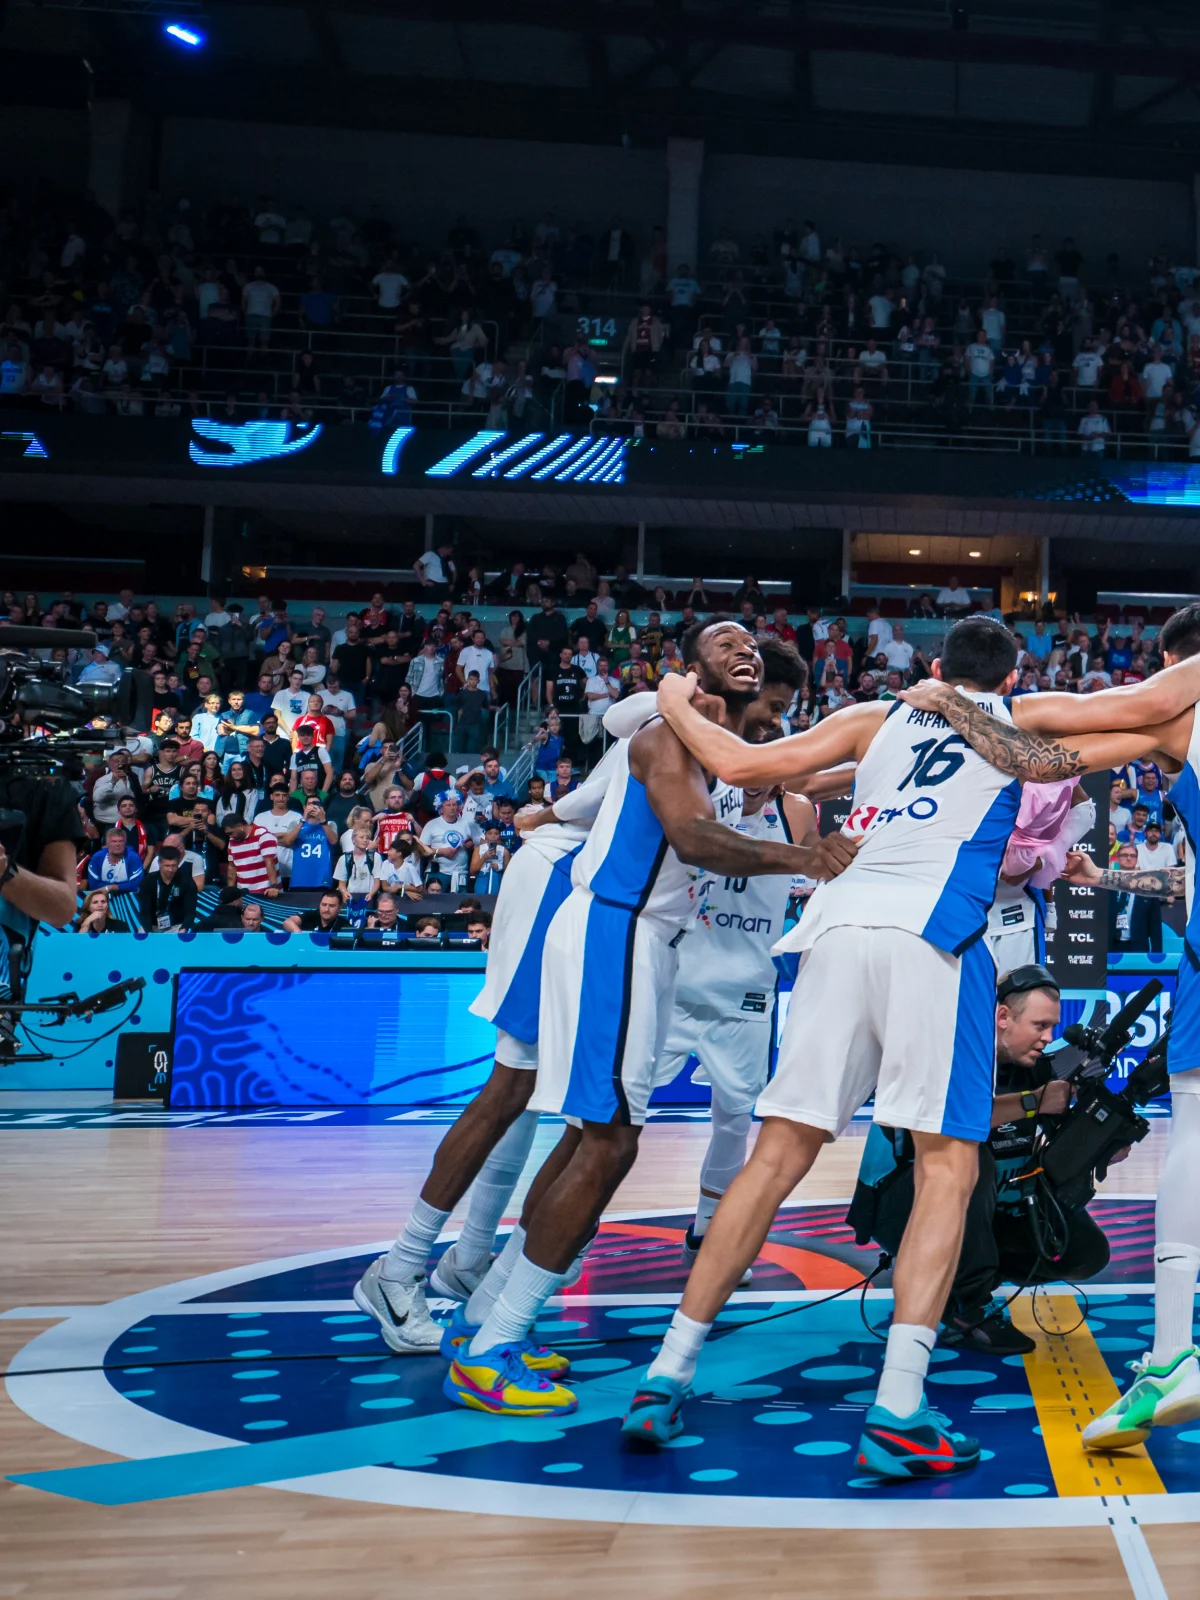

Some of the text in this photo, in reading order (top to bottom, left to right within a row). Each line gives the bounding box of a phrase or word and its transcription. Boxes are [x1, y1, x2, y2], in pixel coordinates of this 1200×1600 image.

[896, 734, 974, 792] 16
[300, 843, 323, 859] 34
[1069, 886, 1095, 896] TCL
[1068, 933, 1095, 943] TCL
